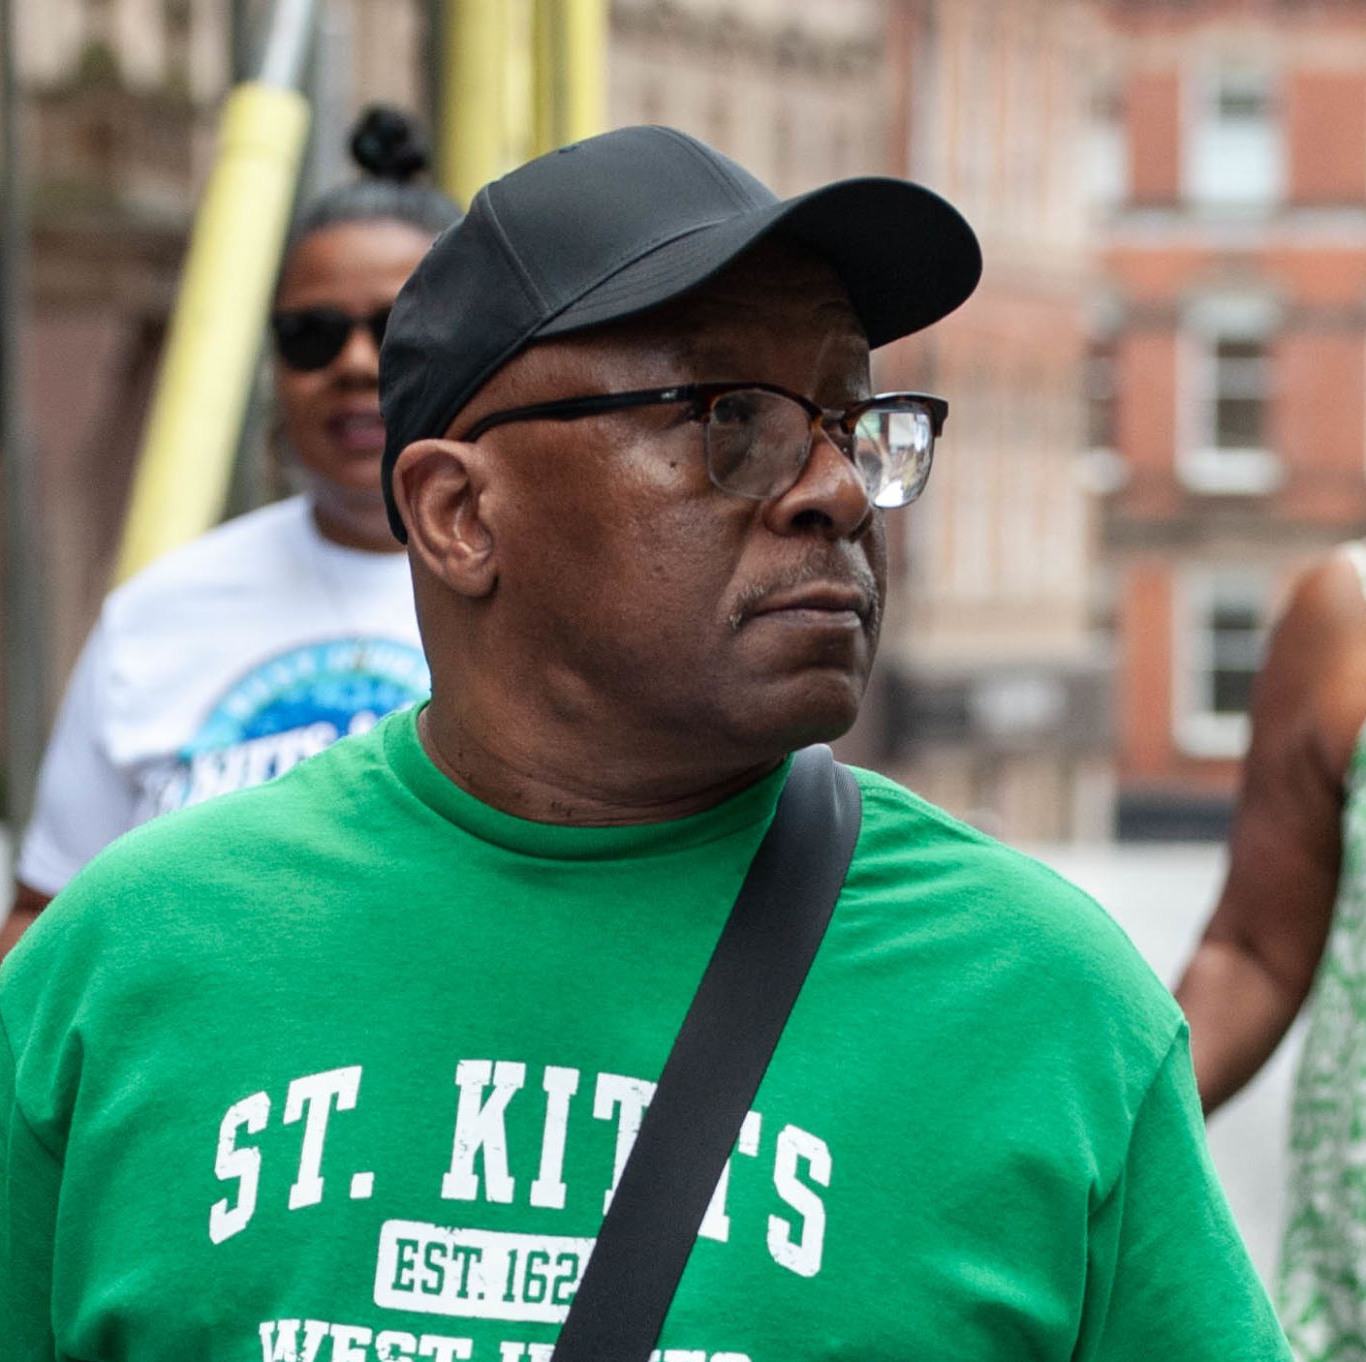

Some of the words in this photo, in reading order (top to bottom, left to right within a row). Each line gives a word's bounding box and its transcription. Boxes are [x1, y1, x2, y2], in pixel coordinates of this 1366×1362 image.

[208, 1065, 375, 1246] ST.
[391, 1237, 485, 1300] EST.
[502, 1248, 580, 1306] 162
